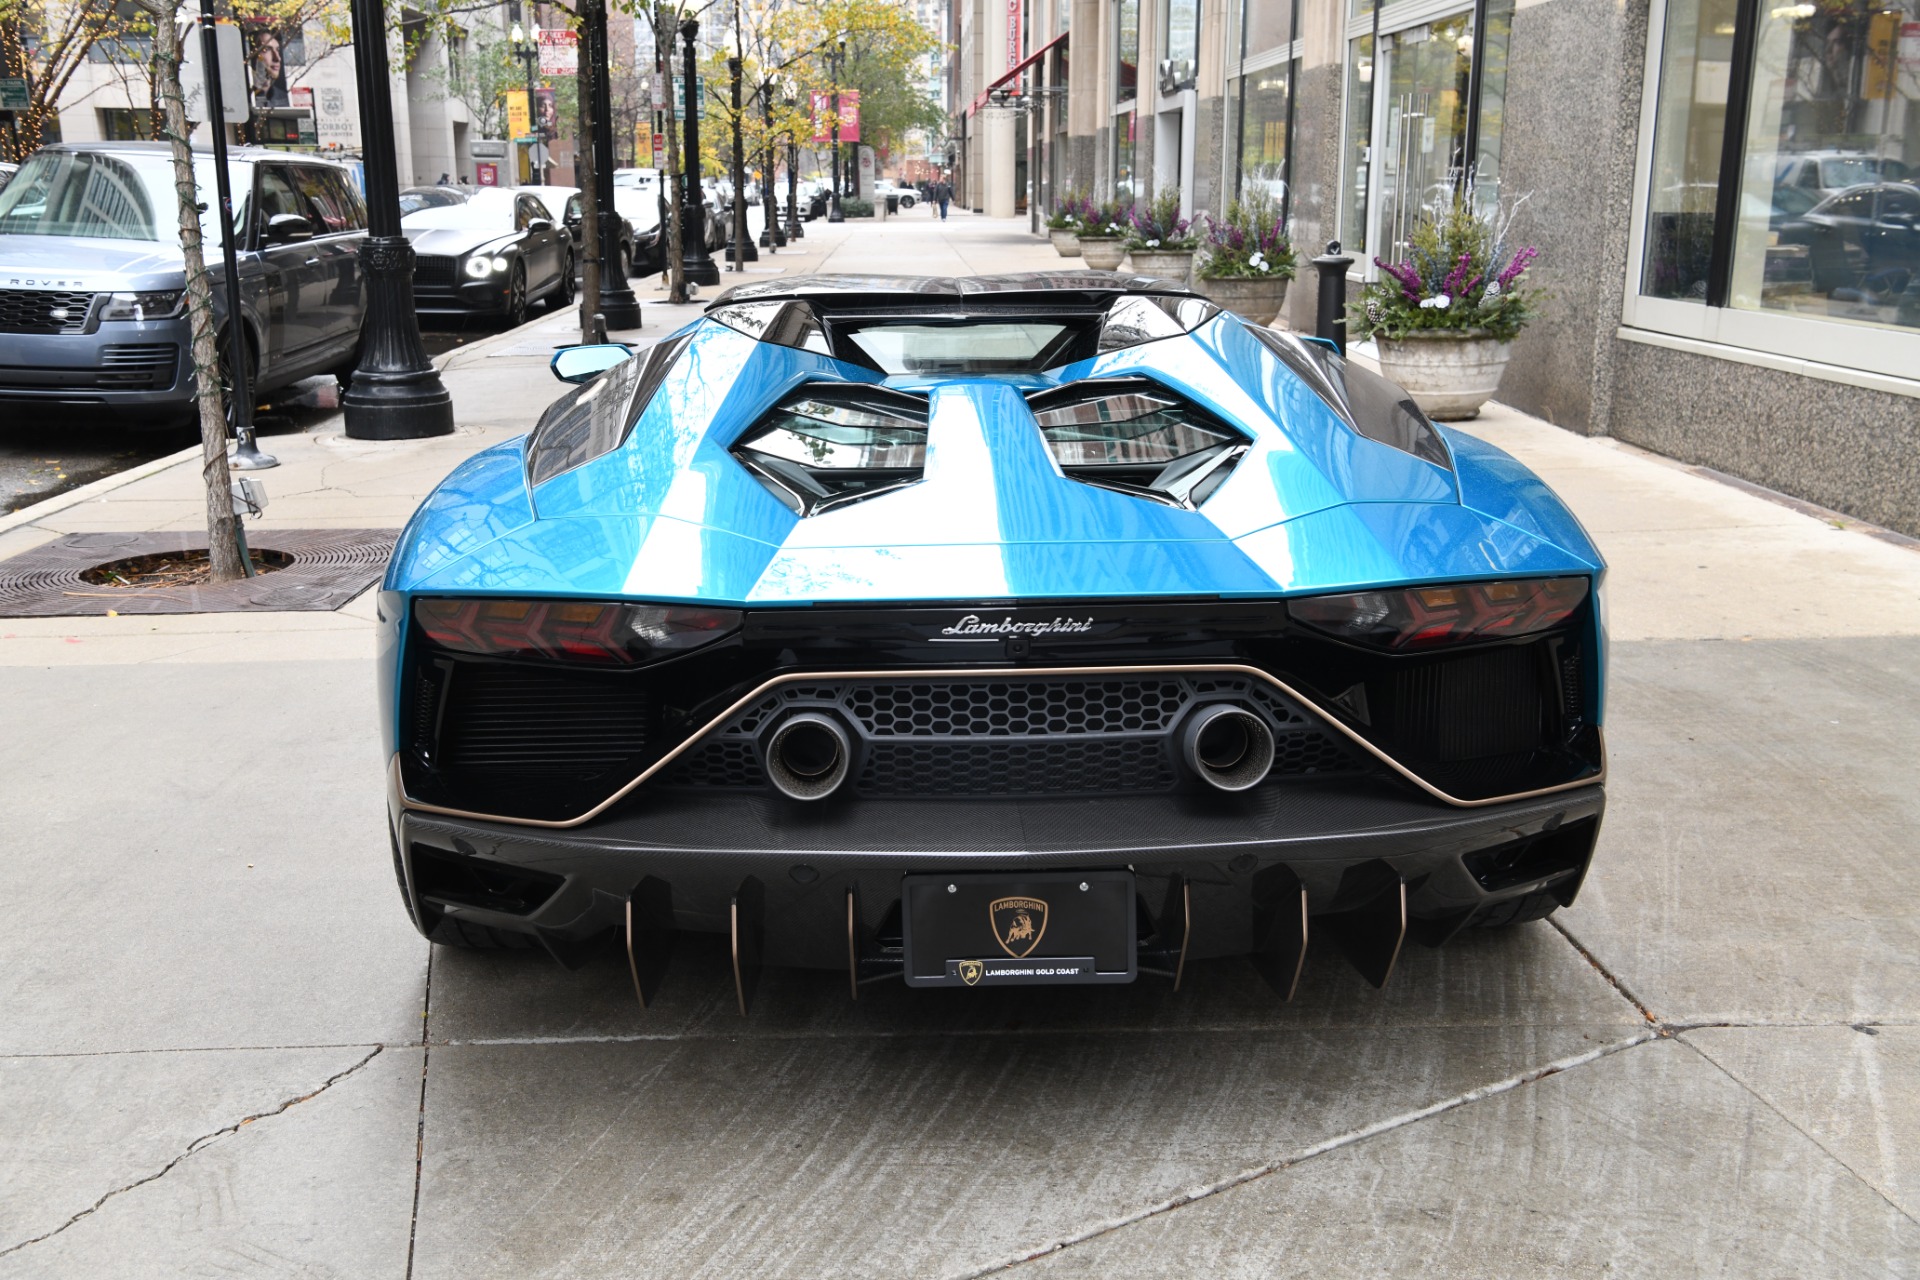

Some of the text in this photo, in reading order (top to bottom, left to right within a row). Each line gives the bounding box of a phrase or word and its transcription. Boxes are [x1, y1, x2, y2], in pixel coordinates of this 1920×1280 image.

[10, 279, 83, 287] ROVER
[941, 614, 1094, 636] Lamborghini
[994, 900, 1044, 913] LAMBORGHINI
[985, 969, 1035, 977] LAMBORGHINI
[1035, 968, 1055, 976] GOLD
